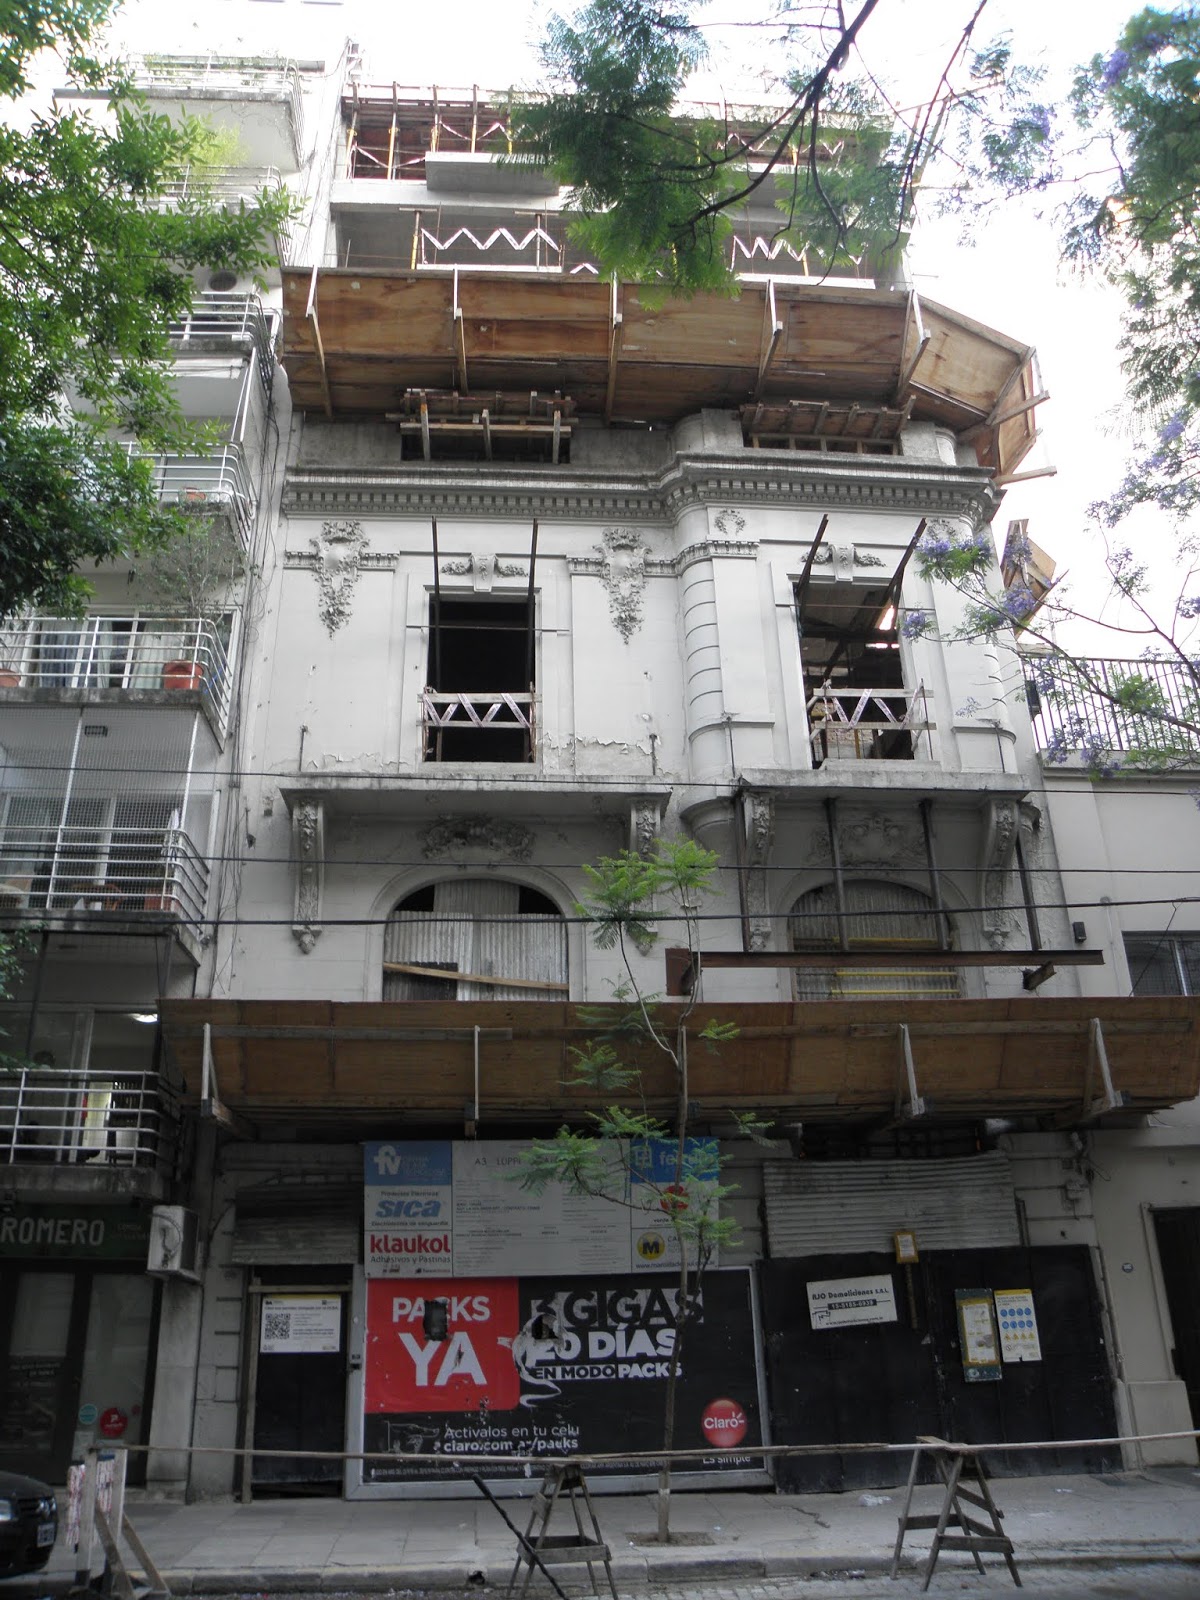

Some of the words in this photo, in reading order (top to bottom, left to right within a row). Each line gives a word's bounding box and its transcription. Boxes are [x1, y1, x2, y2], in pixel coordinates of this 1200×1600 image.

[475, 1157, 487, 1165] A3
[1, 1217, 105, 1246] ROMERO
[370, 1234, 450, 1254] klaukol
[371, 1255, 410, 1263] Adhesivos
[419, 1255, 450, 1263] Pastinas
[828, 1288, 873, 1299] Demoliciones
[393, 1296, 490, 1322] PAKS
[564, 1287, 703, 1327] GIGAS
[588, 1322, 682, 1358] DÍAS
[398, 1331, 488, 1386] YA
[535, 1367, 557, 1379] EN
[561, 1364, 615, 1378] MODO
[618, 1362, 682, 1378] PACKS
[512, 1428, 528, 1437] en
[533, 1425, 547, 1436] tu
[551, 1424, 579, 1436] celu
[704, 1416, 740, 1429] Claro
[444, 1437, 578, 1451] claro.comar/packs
